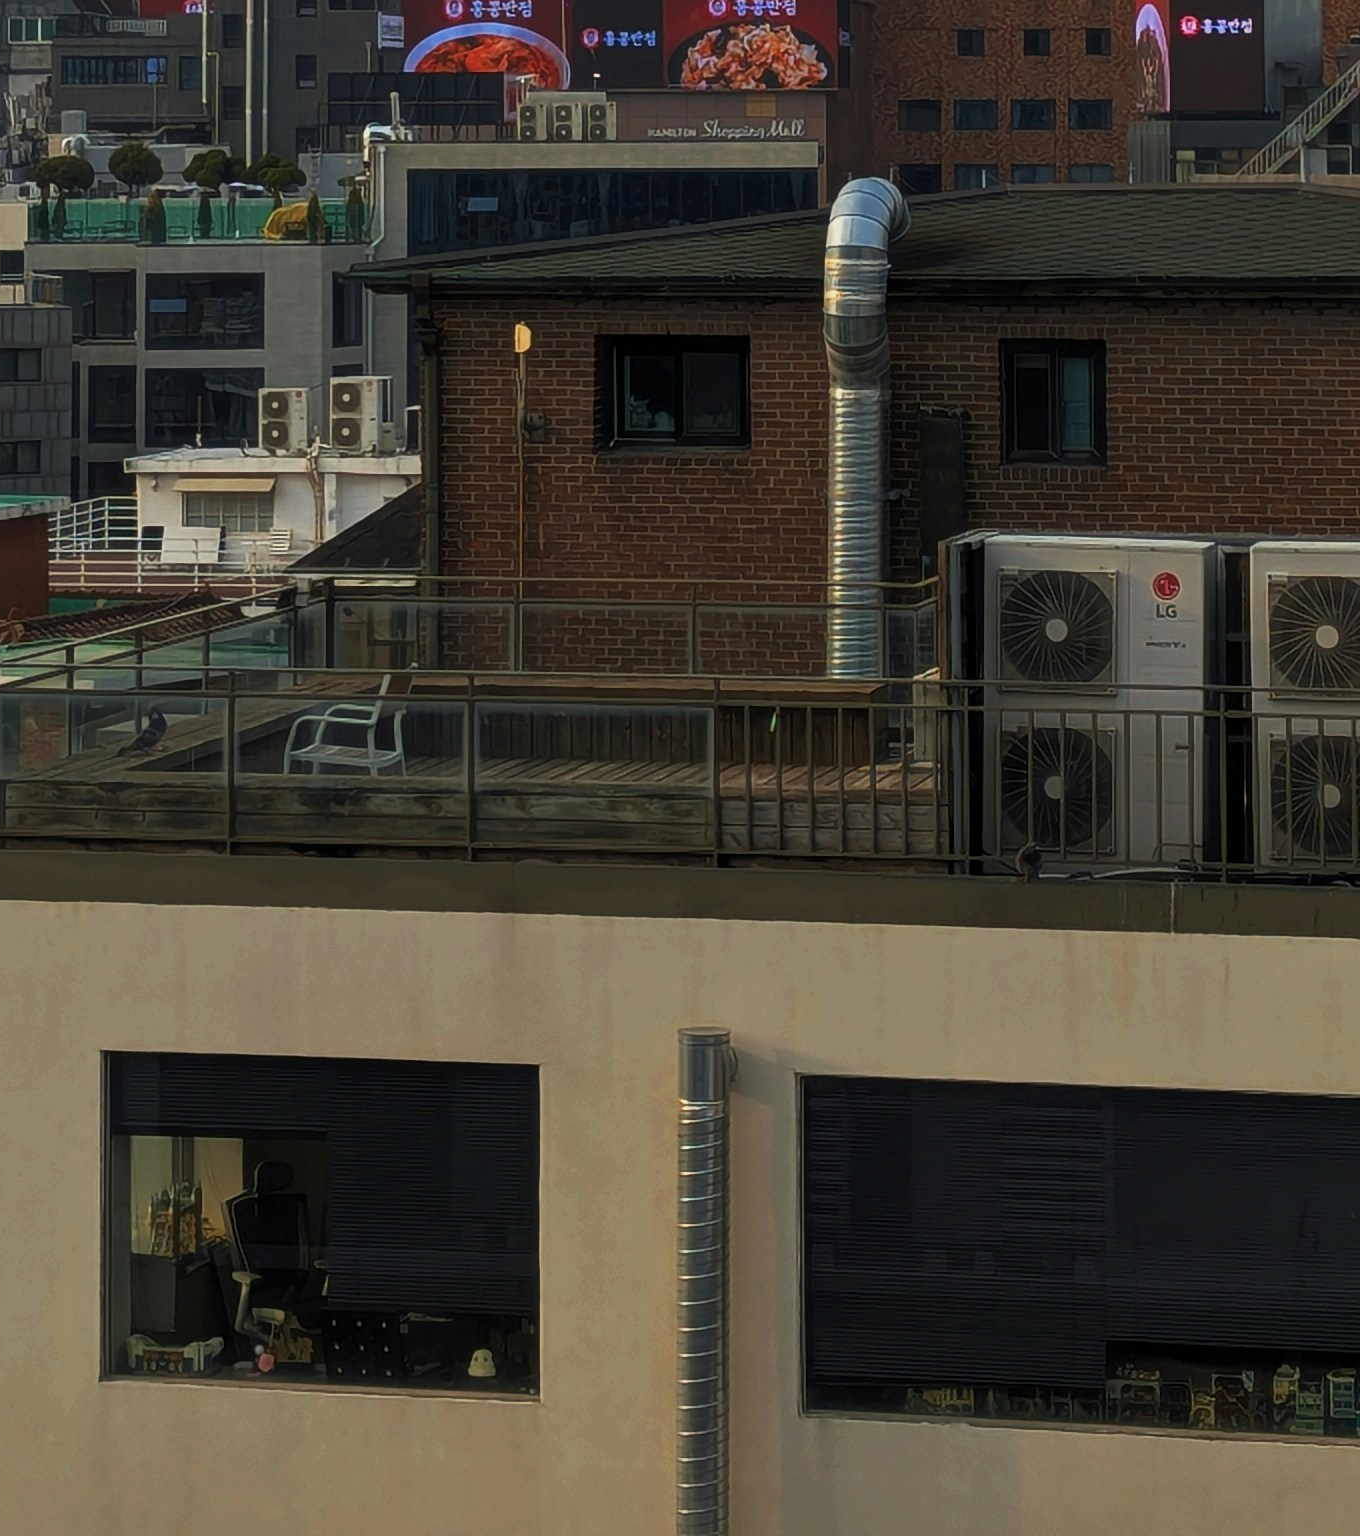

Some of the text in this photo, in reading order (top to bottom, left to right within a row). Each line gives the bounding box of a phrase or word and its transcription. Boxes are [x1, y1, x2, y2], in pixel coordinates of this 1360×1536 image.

[701, 118, 765, 139] Shopping
[766, 118, 805, 137] Mall
[1156, 604, 1178, 619] LG
